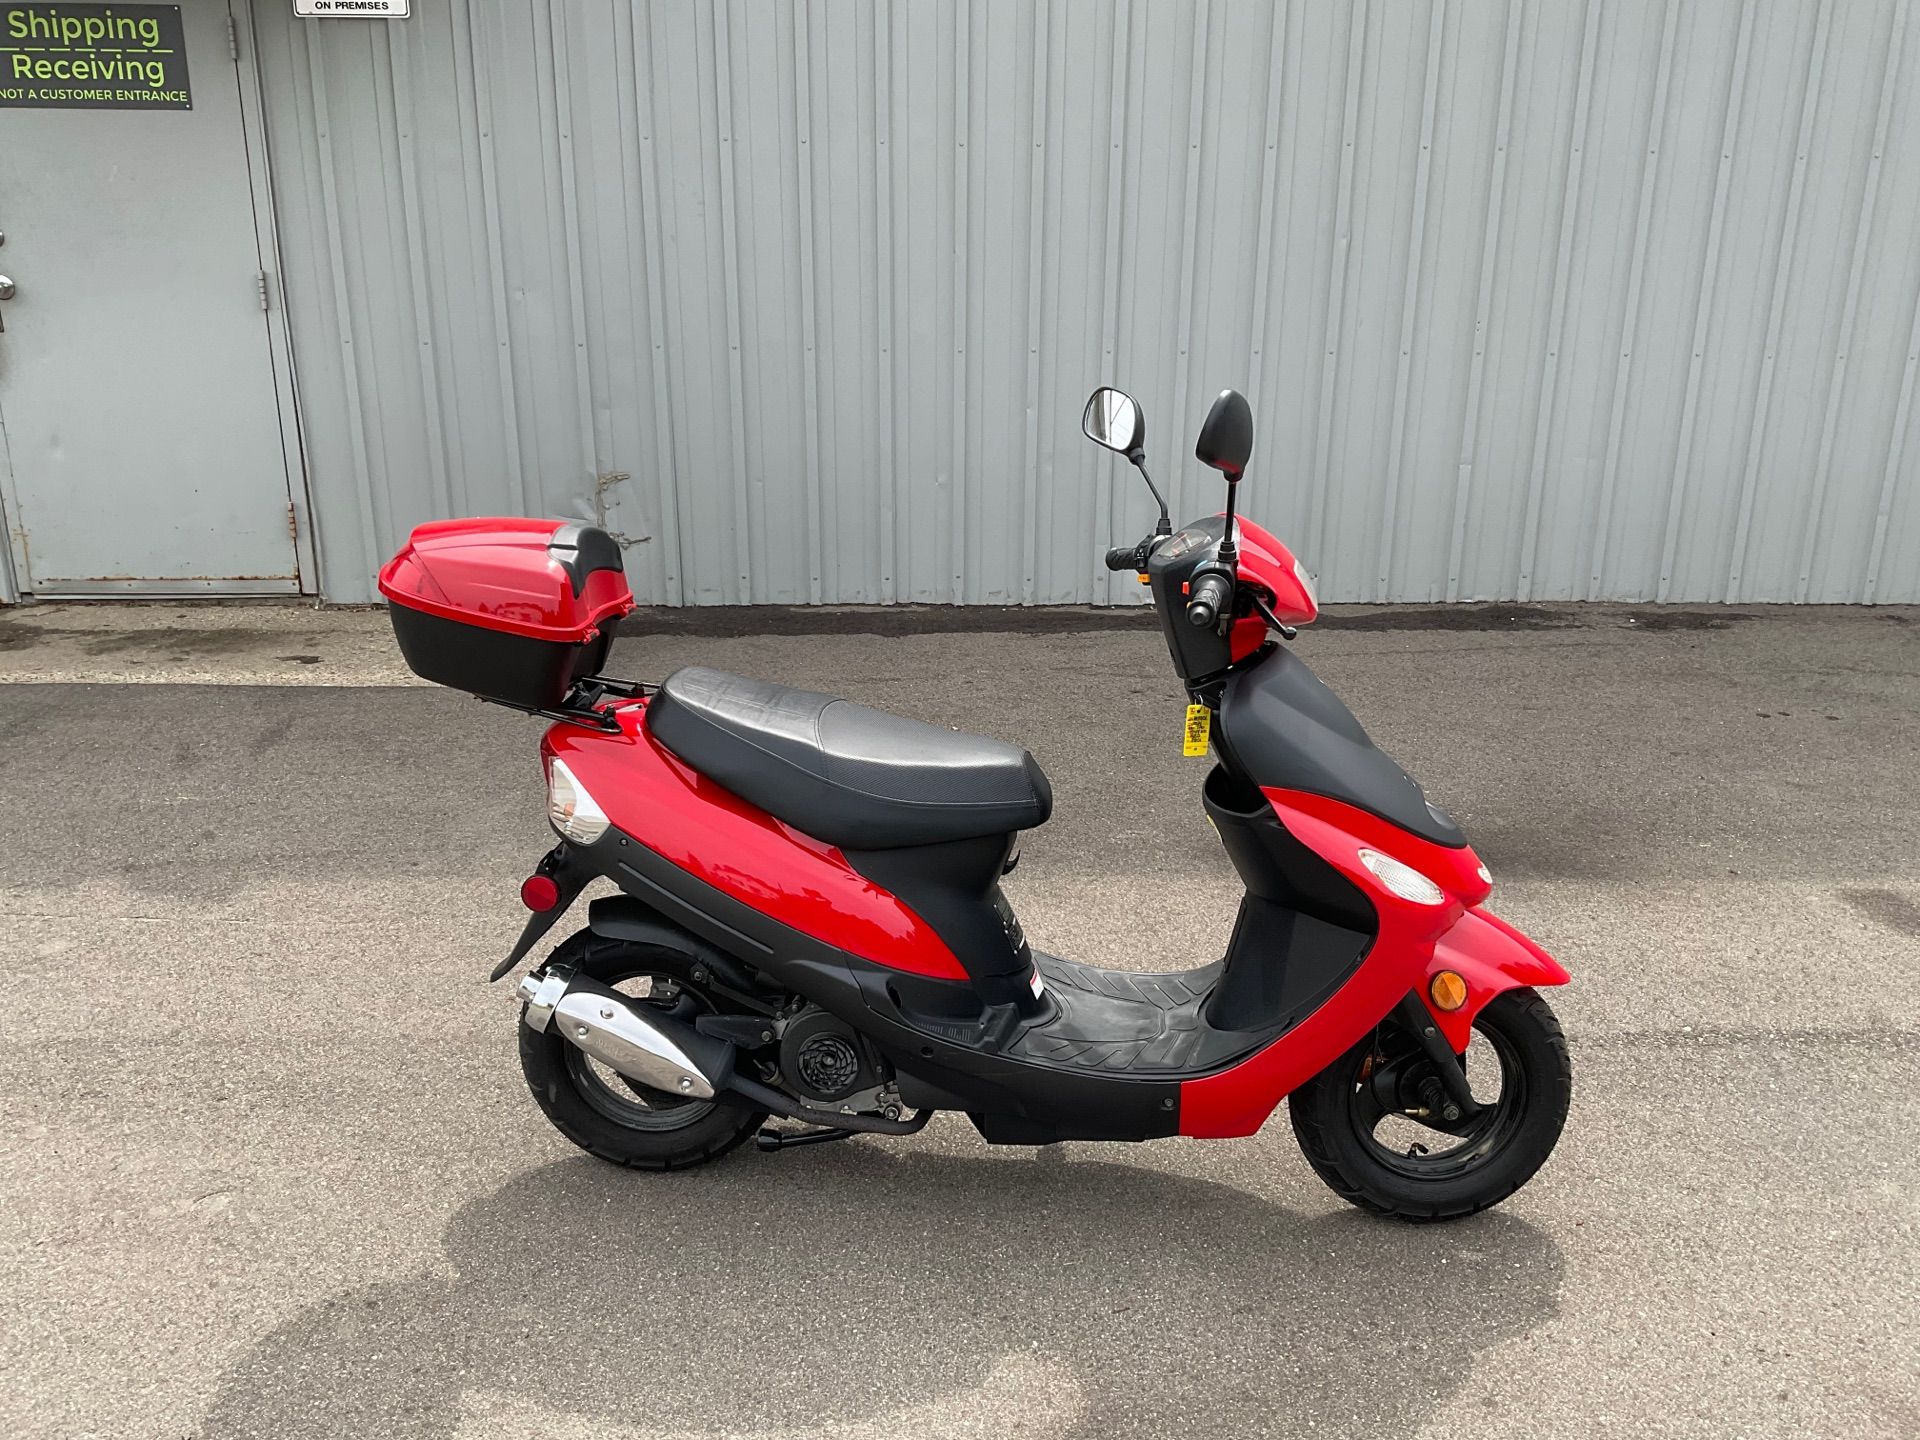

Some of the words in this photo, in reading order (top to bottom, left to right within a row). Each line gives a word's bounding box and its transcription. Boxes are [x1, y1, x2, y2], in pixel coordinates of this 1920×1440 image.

[335, 2, 389, 10] PREMISES
[8, 9, 160, 47] Shipping
[12, 54, 165, 88] Receiving
[28, 89, 38, 99] A
[40, 89, 113, 100] CUSTOMER
[117, 90, 188, 102] ENTRANCE
